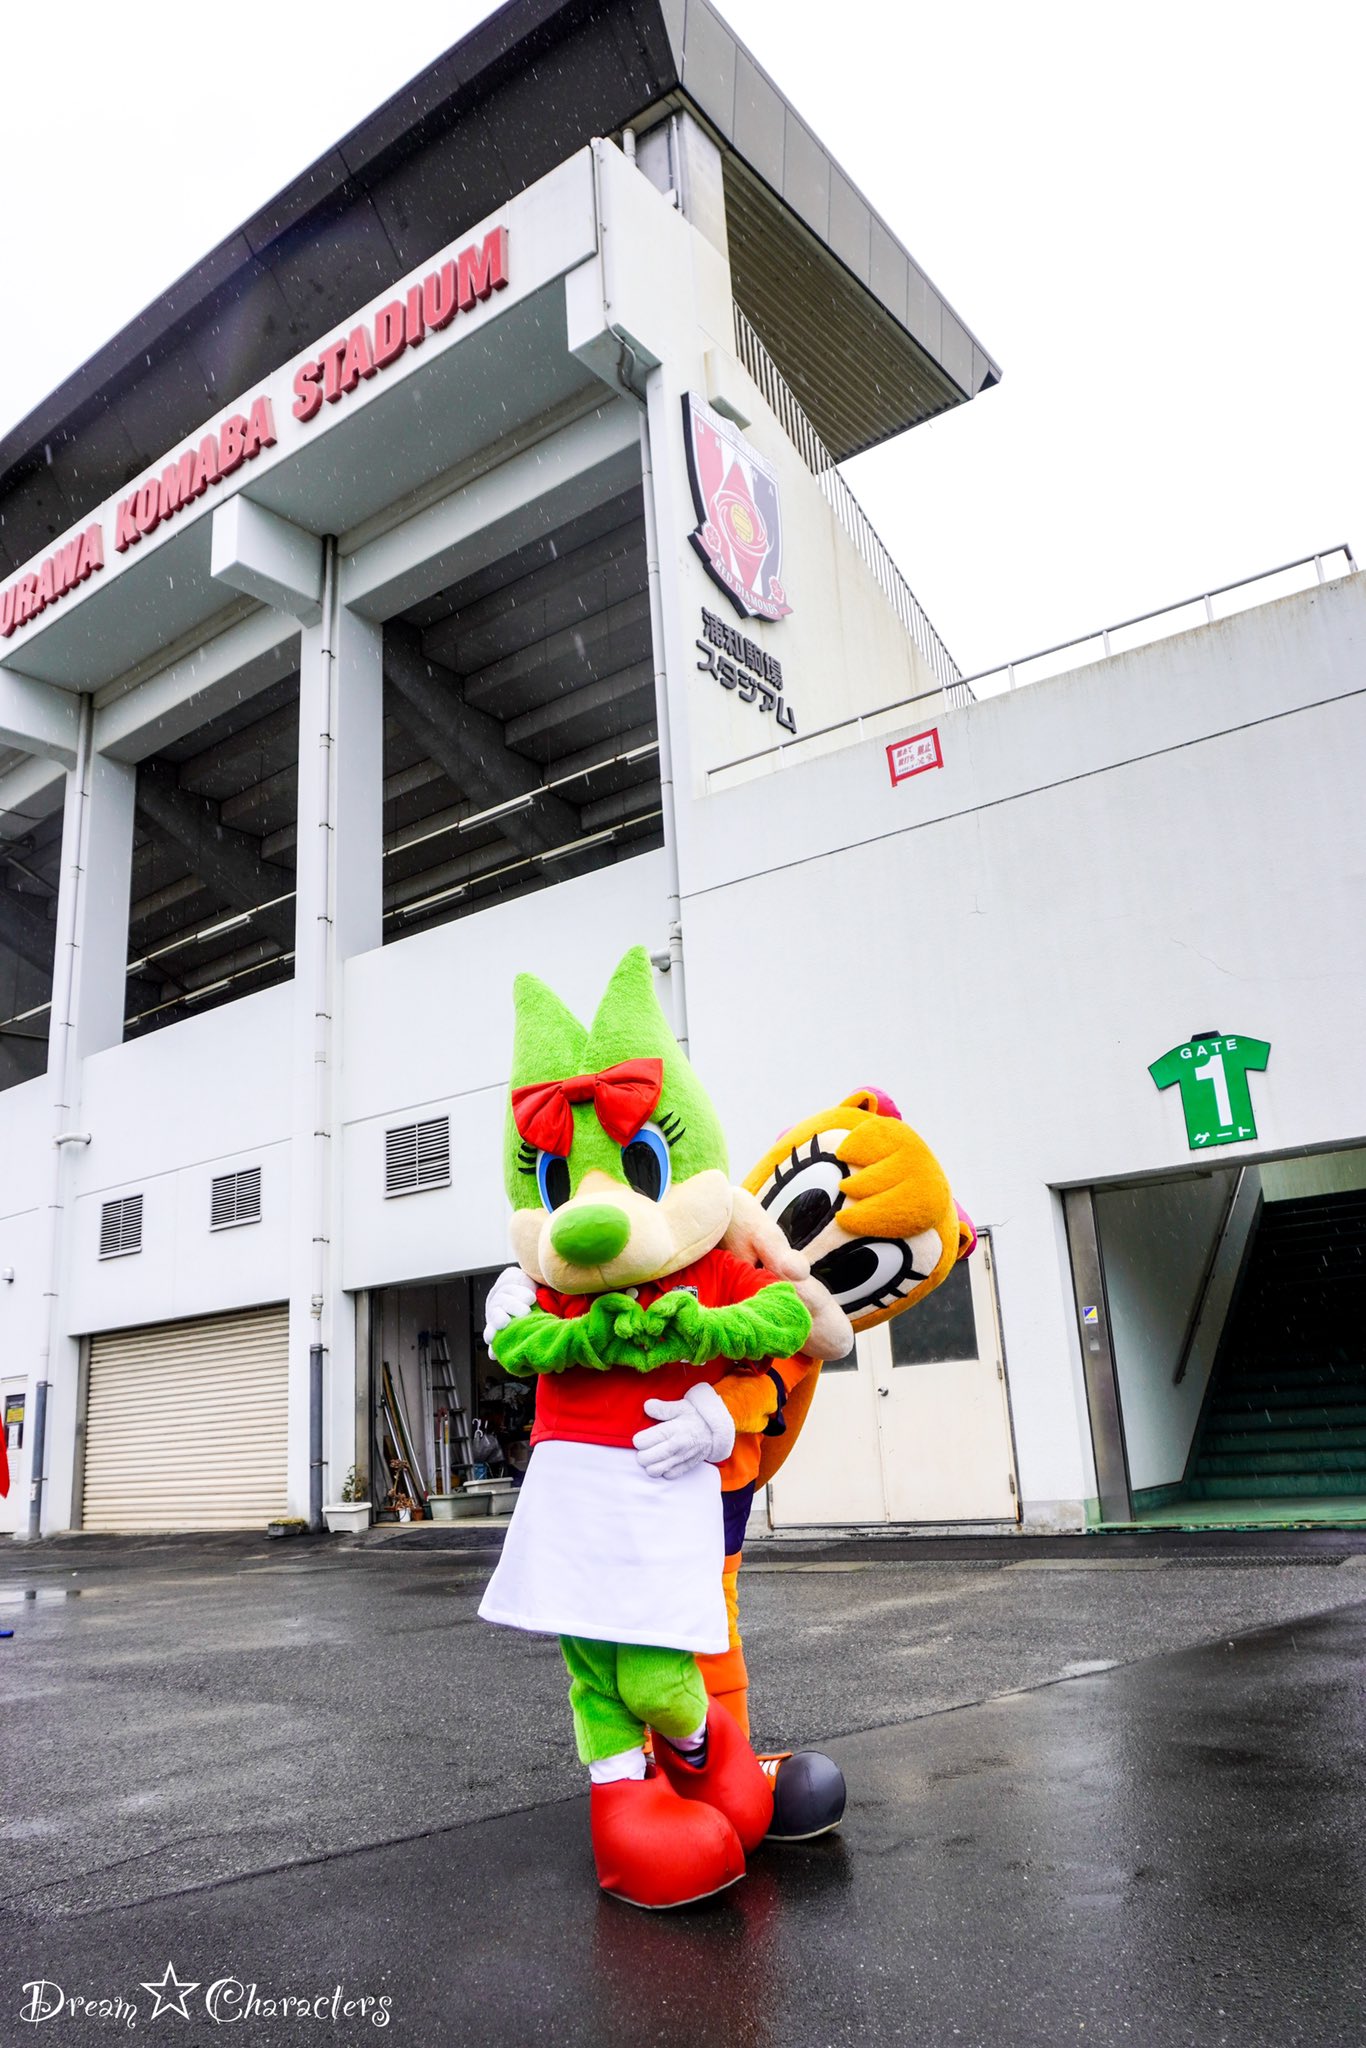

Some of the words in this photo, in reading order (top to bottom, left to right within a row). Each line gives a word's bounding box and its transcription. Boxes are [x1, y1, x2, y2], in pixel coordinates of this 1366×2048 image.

[0, 523, 104, 637] URAWA
[115, 395, 277, 552] KOMABA
[292, 225, 509, 422] STADIUM
[715, 559, 733, 583] RED
[735, 581, 779, 615] DIAMONDS
[701, 606, 783, 691] 浦和駒場
[696, 639, 797, 734] スタジアム
[1180, 1038, 1238, 1059] GATE
[1194, 1054, 1233, 1127] 1
[1194, 1126, 1251, 1144] ゲート
